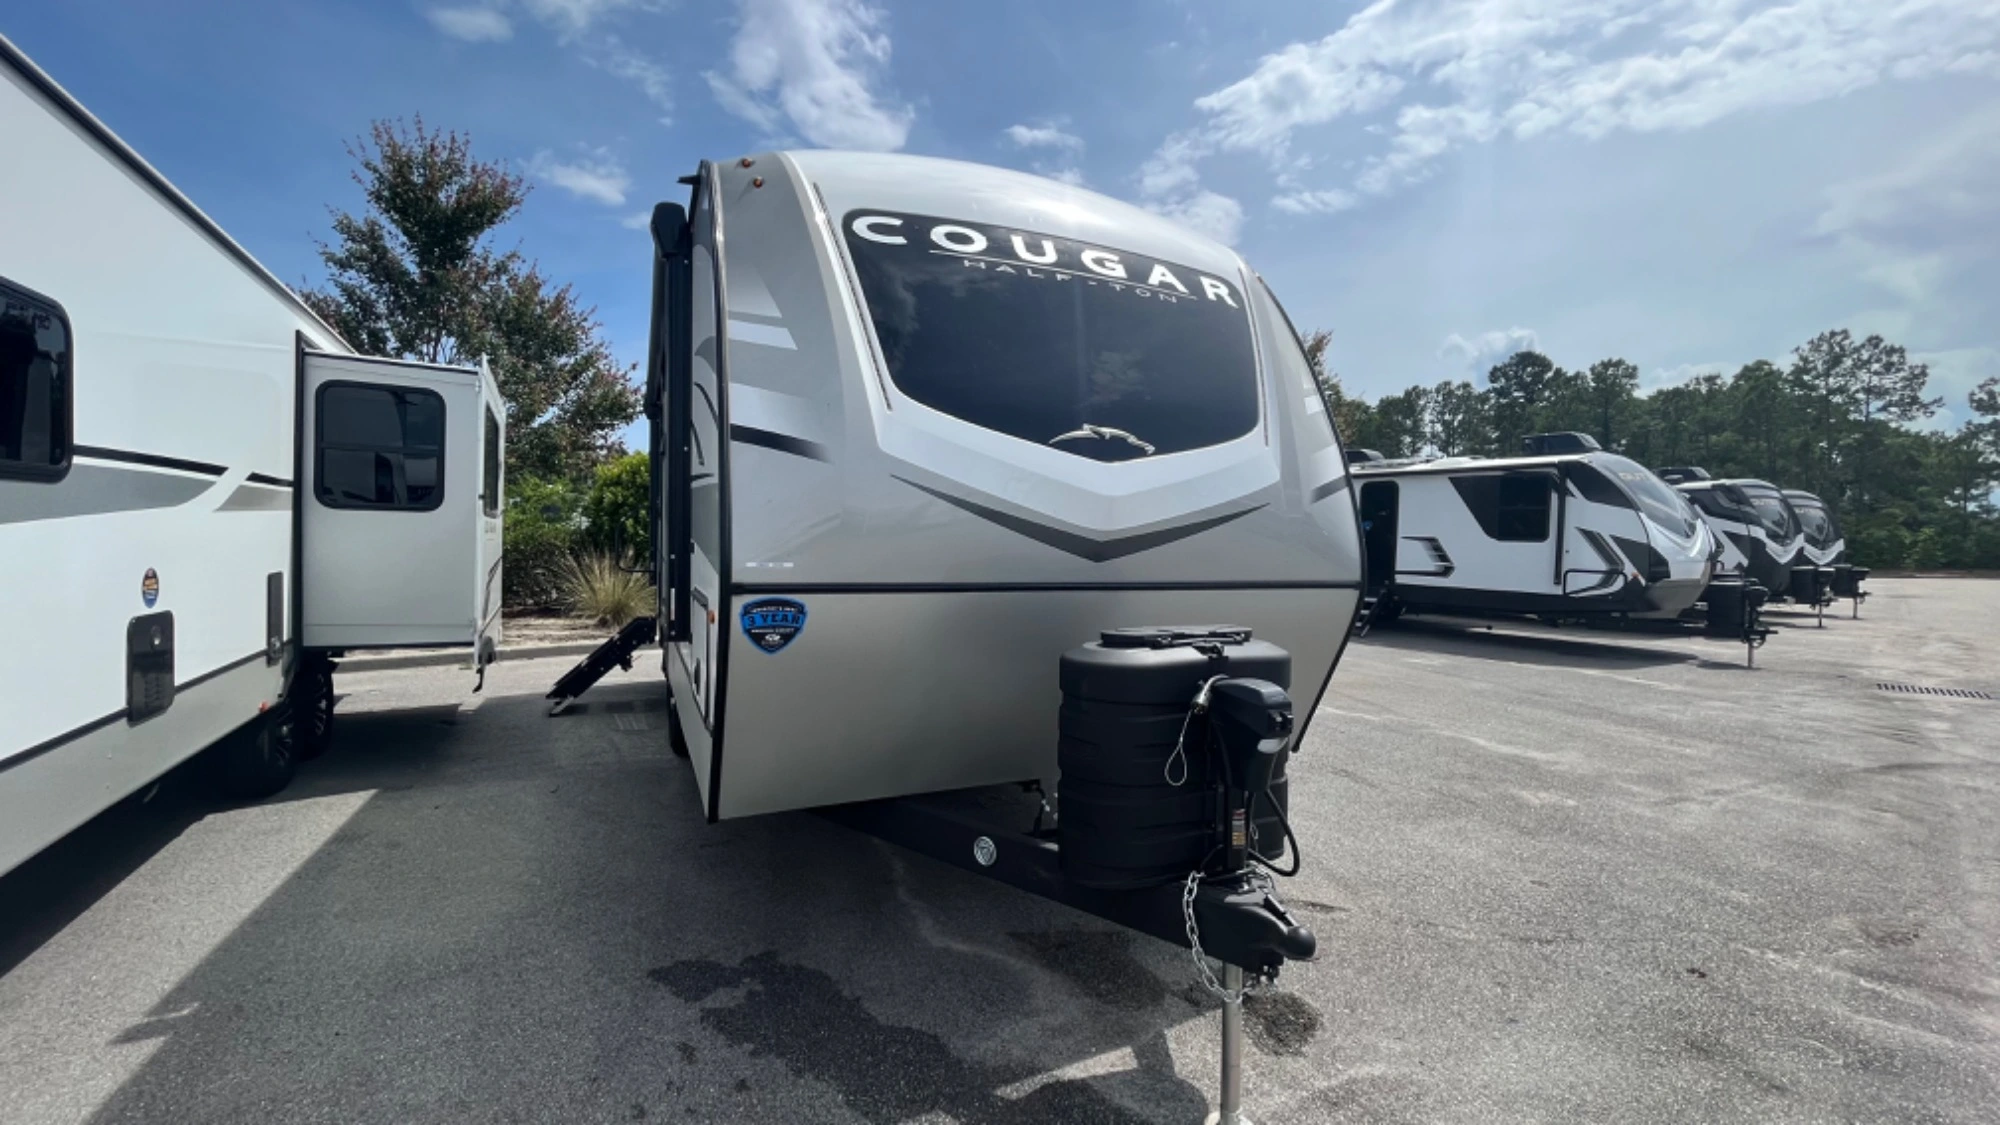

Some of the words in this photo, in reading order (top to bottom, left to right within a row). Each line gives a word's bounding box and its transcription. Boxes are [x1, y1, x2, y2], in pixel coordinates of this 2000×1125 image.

[852, 215, 1239, 309] COUGAR
[747, 614, 757, 627] 3
[760, 612, 800, 625] YEAR
